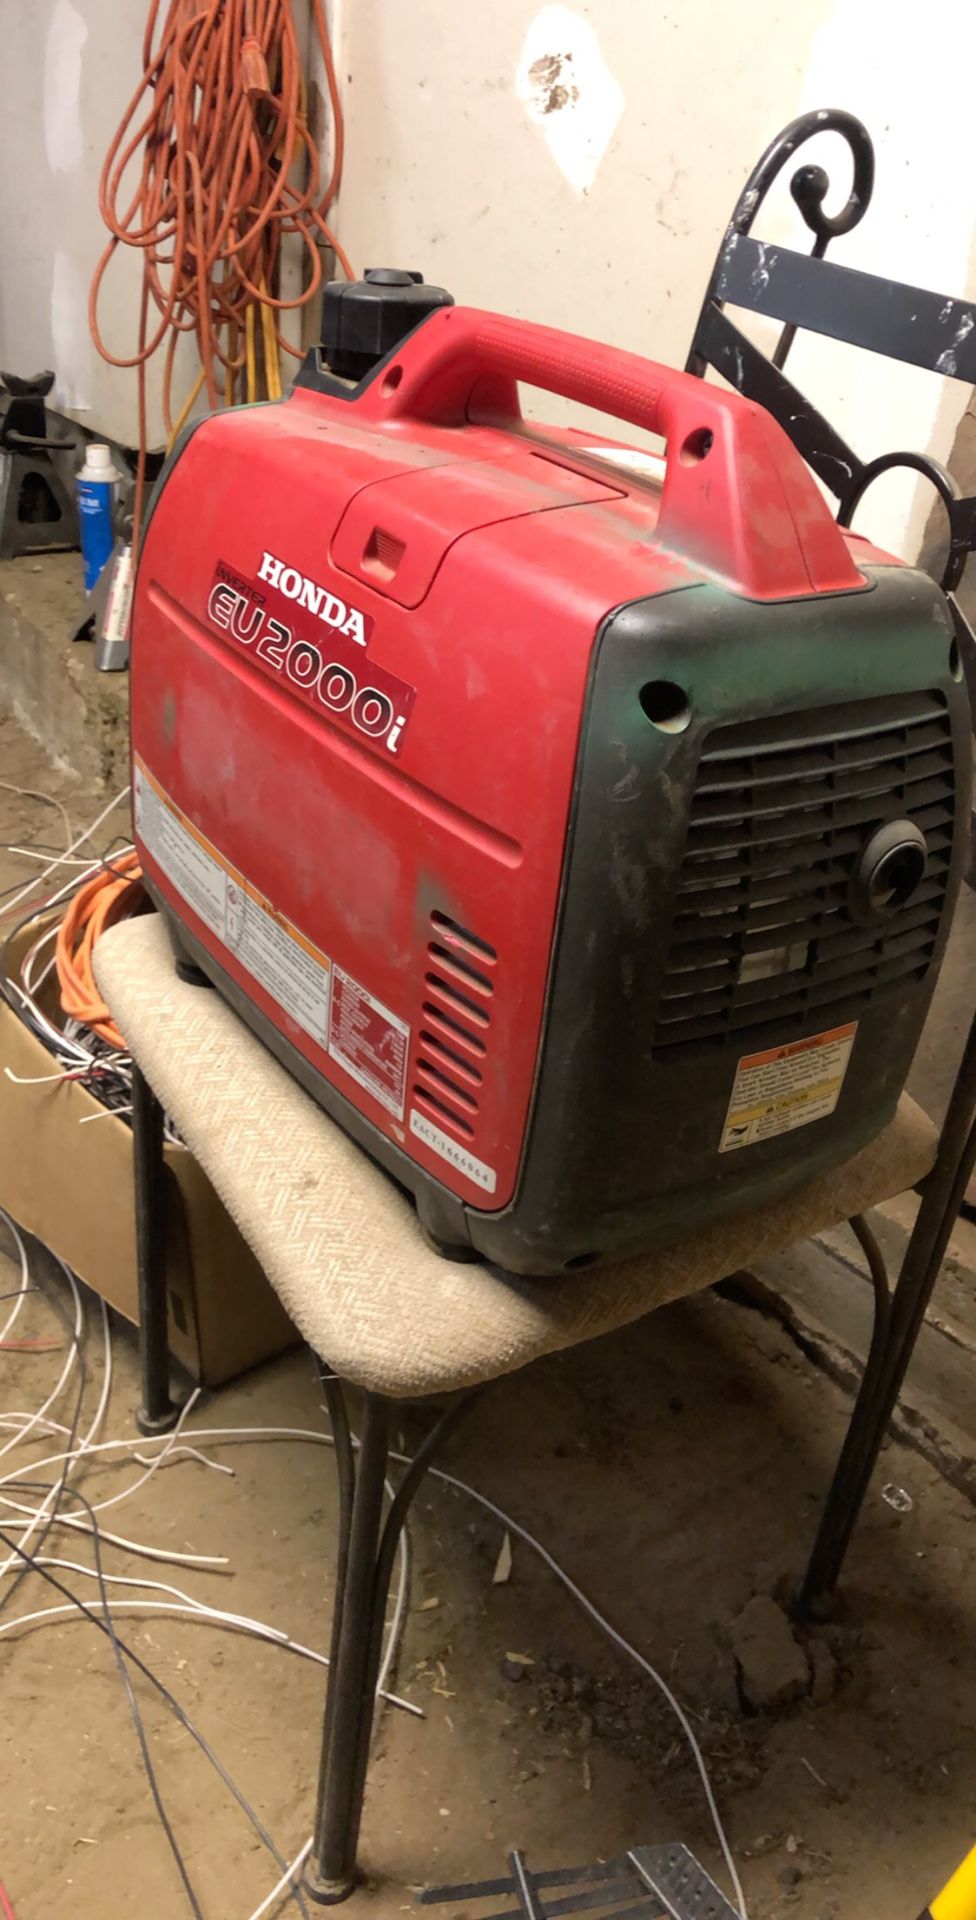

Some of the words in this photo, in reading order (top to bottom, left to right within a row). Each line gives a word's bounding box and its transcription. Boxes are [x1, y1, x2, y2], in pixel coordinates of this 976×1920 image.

[216, 567, 266, 605] INVERTER
[257, 552, 367, 646] HONDA
[208, 583, 406, 752] EU2000i
